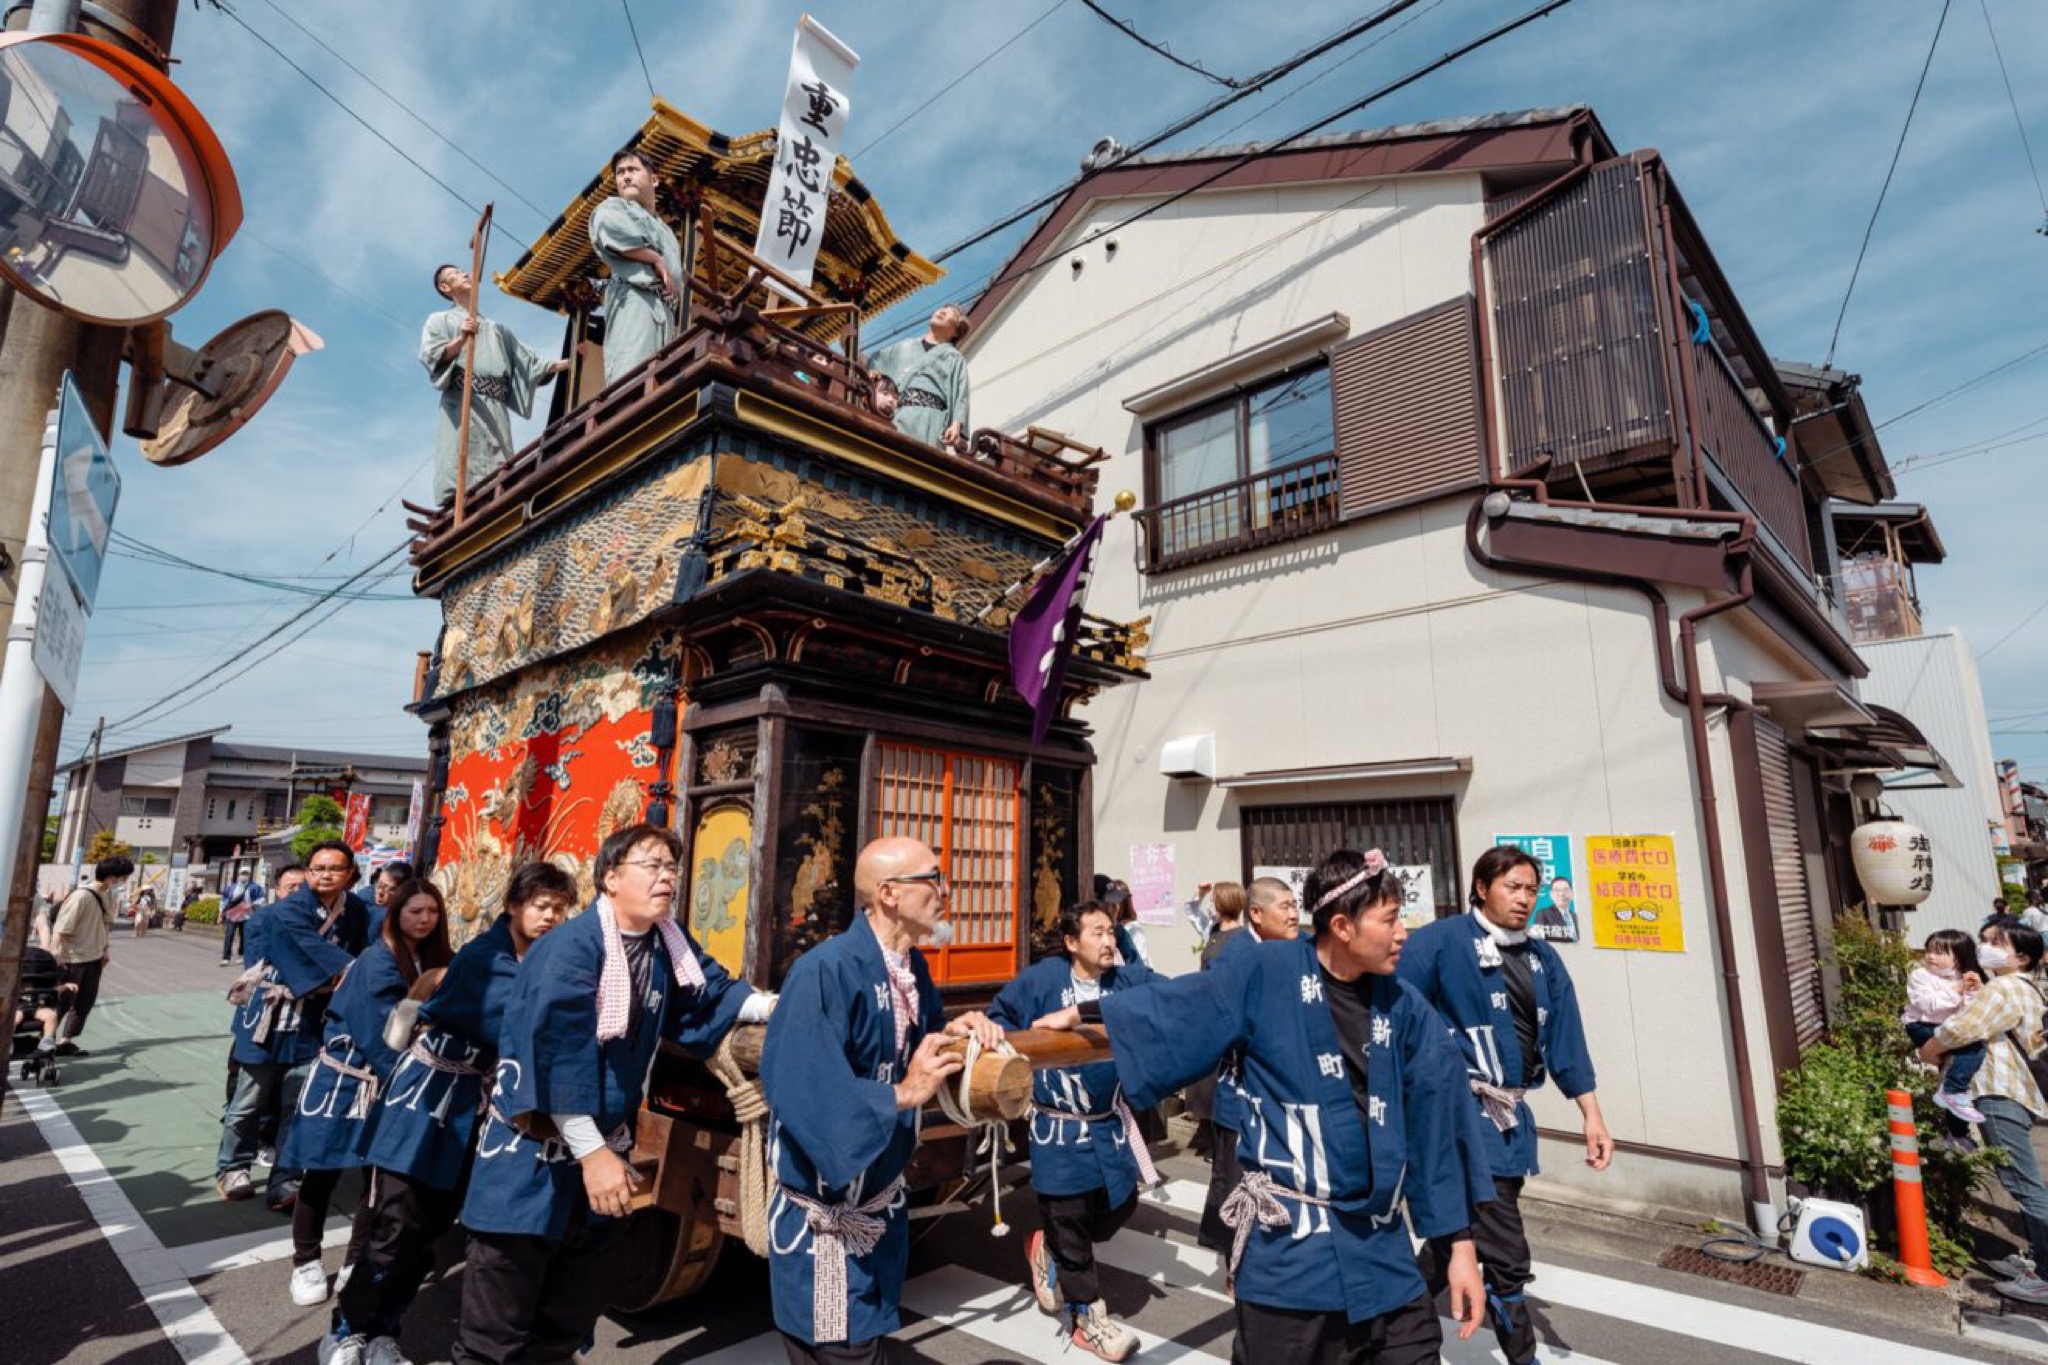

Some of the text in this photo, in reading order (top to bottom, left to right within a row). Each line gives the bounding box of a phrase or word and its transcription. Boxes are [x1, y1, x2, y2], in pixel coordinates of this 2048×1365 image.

[777, 82, 840, 260] 重忠節
[1593, 849, 1669, 865] 医療費ゼロ
[1596, 882, 1673, 898] 給食費ゼロ
